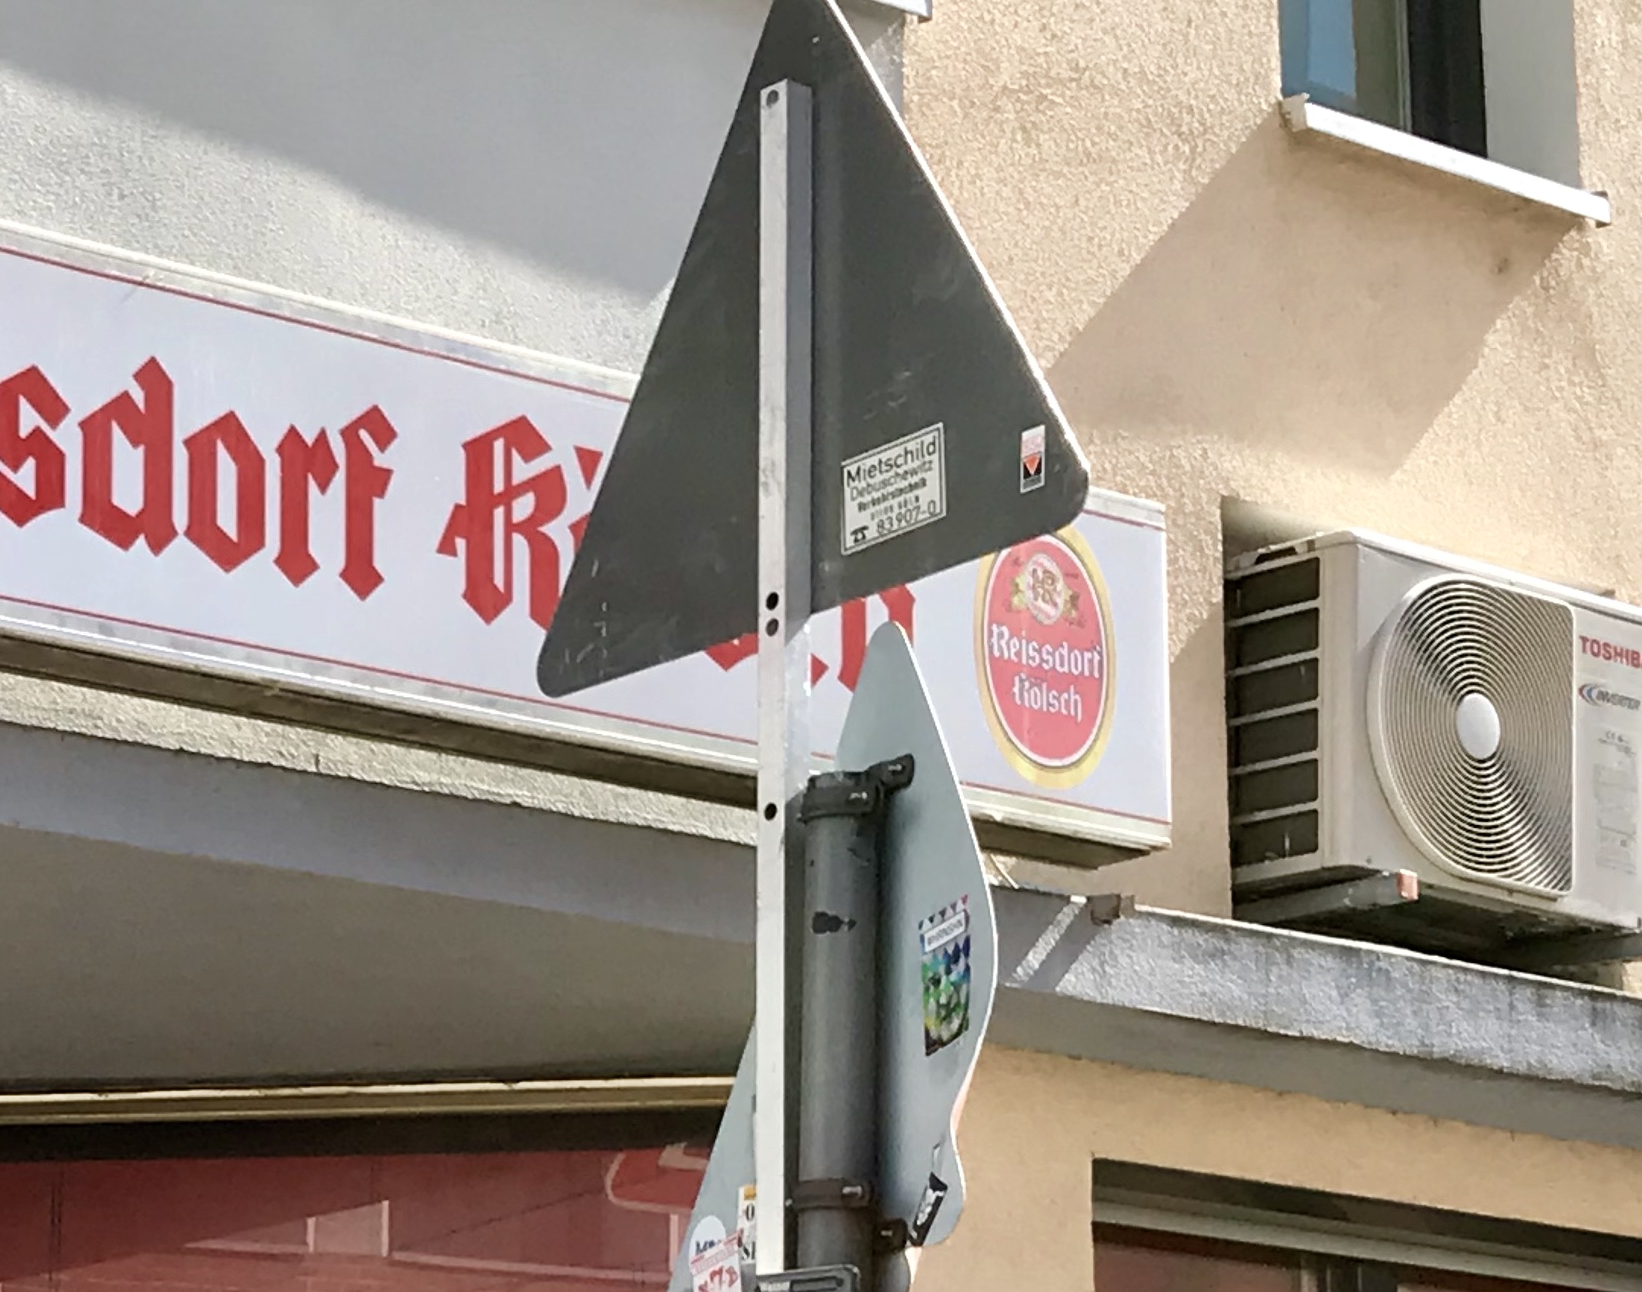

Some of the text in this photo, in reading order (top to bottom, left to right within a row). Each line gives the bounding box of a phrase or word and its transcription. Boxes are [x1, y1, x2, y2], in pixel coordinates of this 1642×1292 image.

[846, 435, 937, 488] Mietschild
[850, 459, 933, 502] Debuschewitz
[990, 623, 1102, 679] Reissdorf
[1579, 635, 1642, 671] TOSHIB
[1012, 672, 1082, 723] Kölsch
